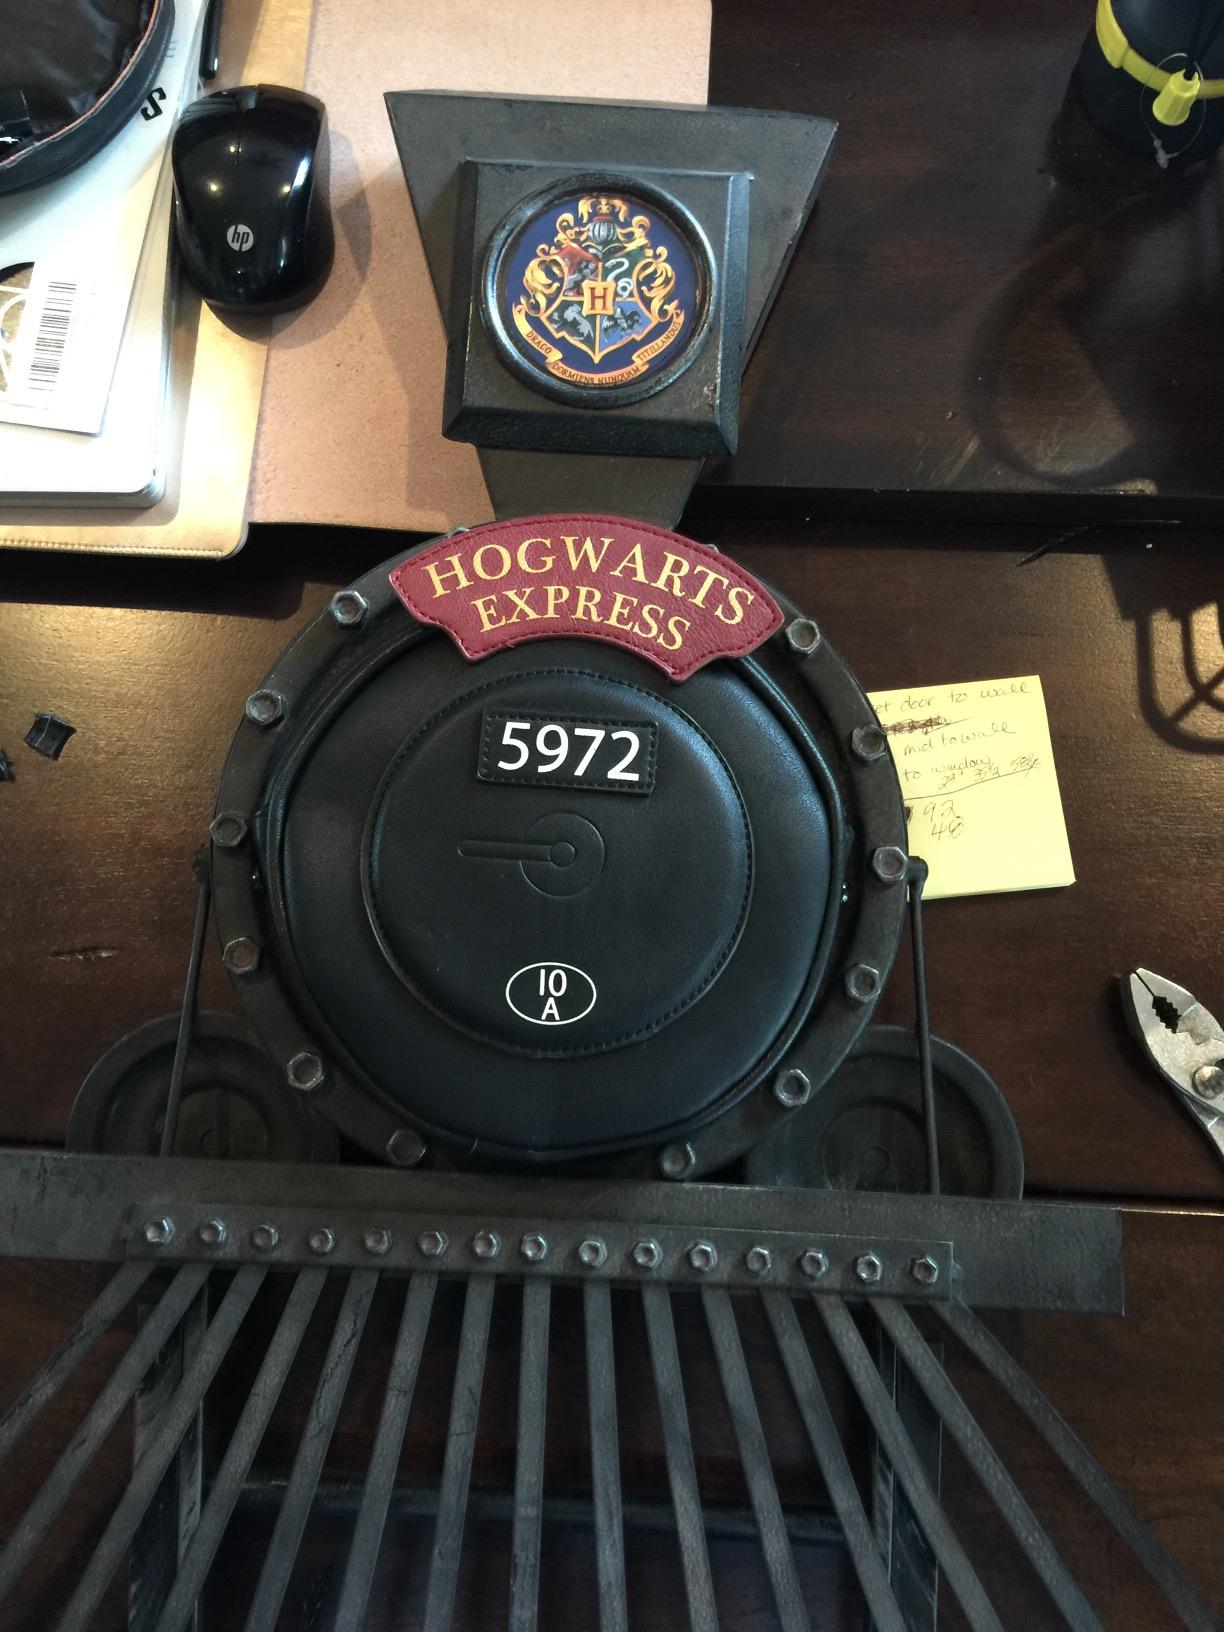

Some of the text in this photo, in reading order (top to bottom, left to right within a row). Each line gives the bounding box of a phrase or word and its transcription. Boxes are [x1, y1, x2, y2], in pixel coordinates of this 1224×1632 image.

[229, 224, 252, 251] hp
[589, 287, 609, 310] H
[525, 331, 552, 354] DRACO
[422, 535, 755, 626] HOGWARTS
[470, 585, 691, 651] EXPRESS
[900, 695, 936, 712] door
[950, 688, 969, 702] to
[497, 721, 640, 781] 5972
[903, 769, 922, 782] to
[539, 968, 567, 997] 10
[541, 997, 560, 1021] A
